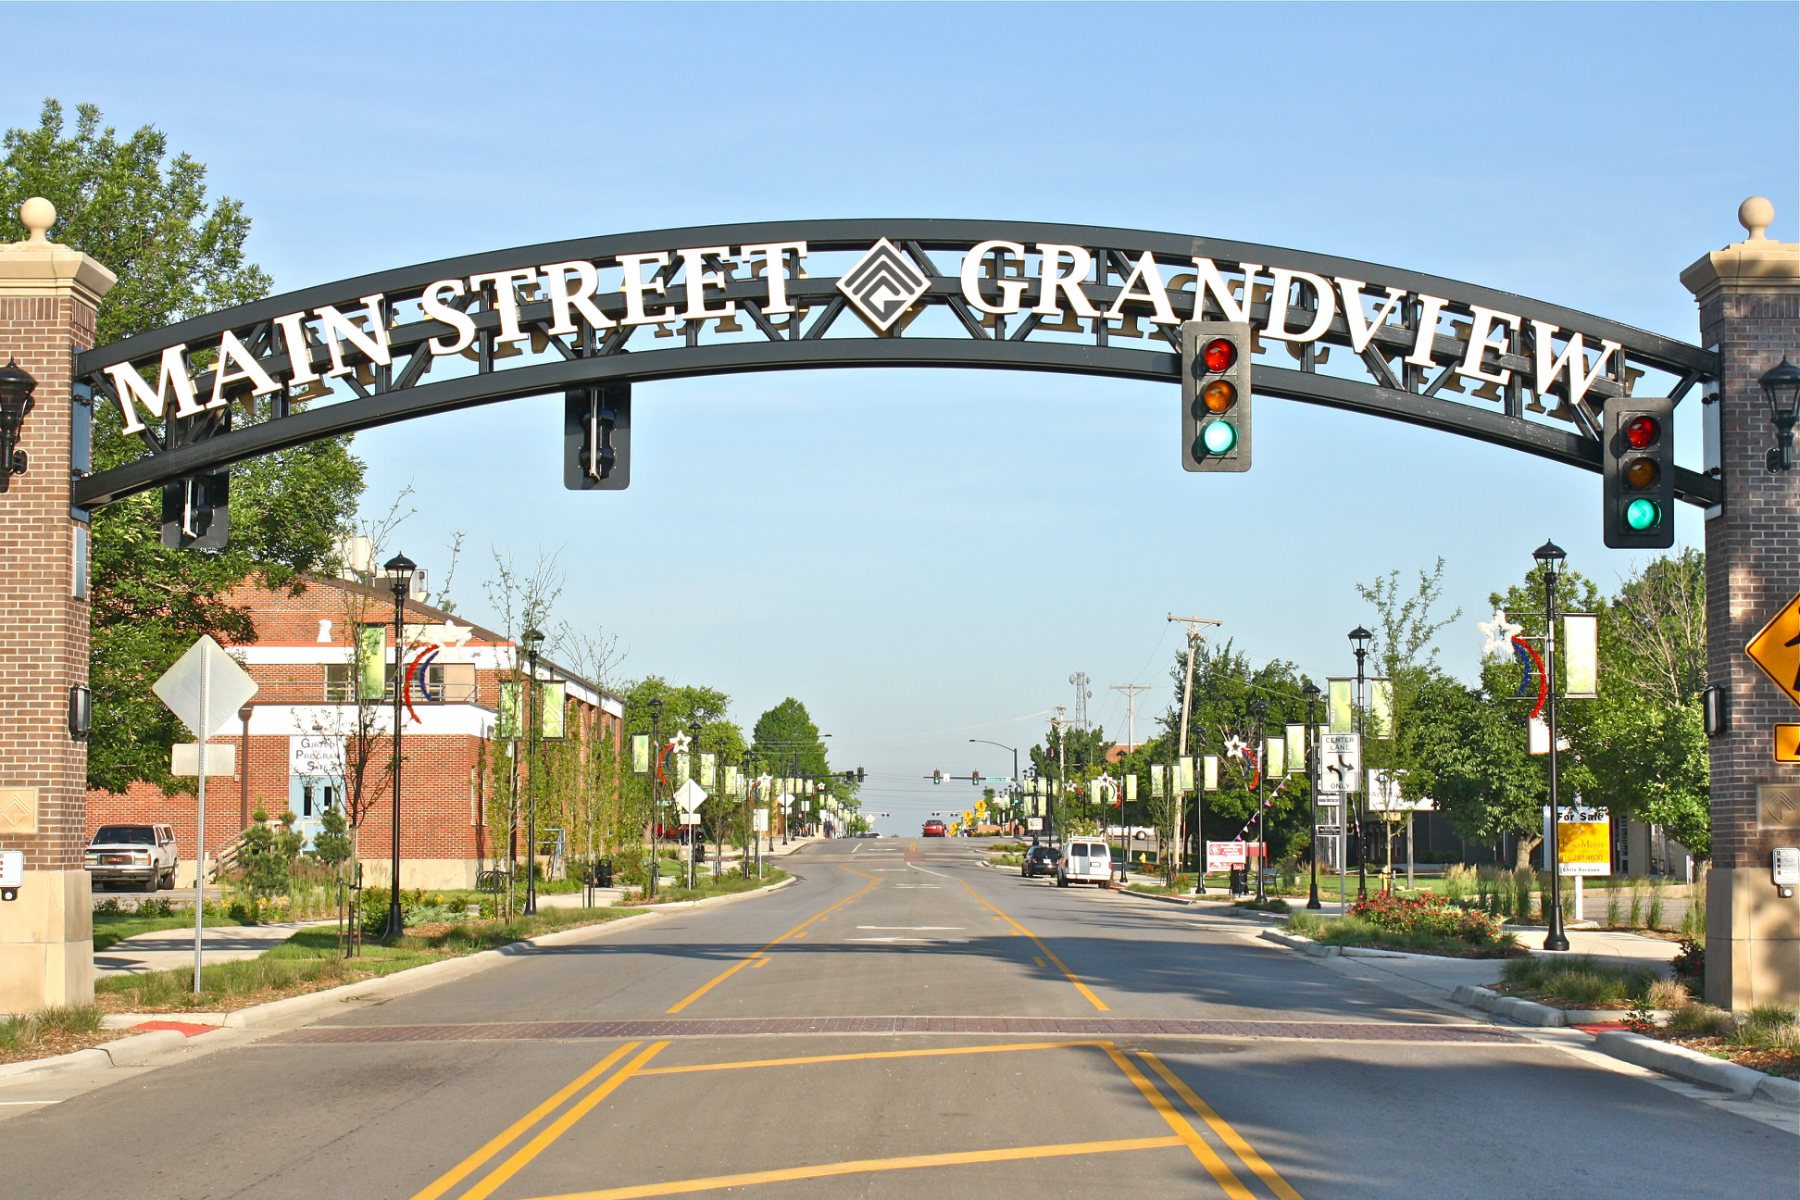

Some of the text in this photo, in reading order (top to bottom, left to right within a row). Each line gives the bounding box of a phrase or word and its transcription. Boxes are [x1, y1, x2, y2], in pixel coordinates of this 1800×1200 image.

[104, 240, 1622, 436] MAIN STREET GRANDVIEW
[1325, 736, 1355, 744] CENTER
[1557, 812, 1604, 821] For Sale
